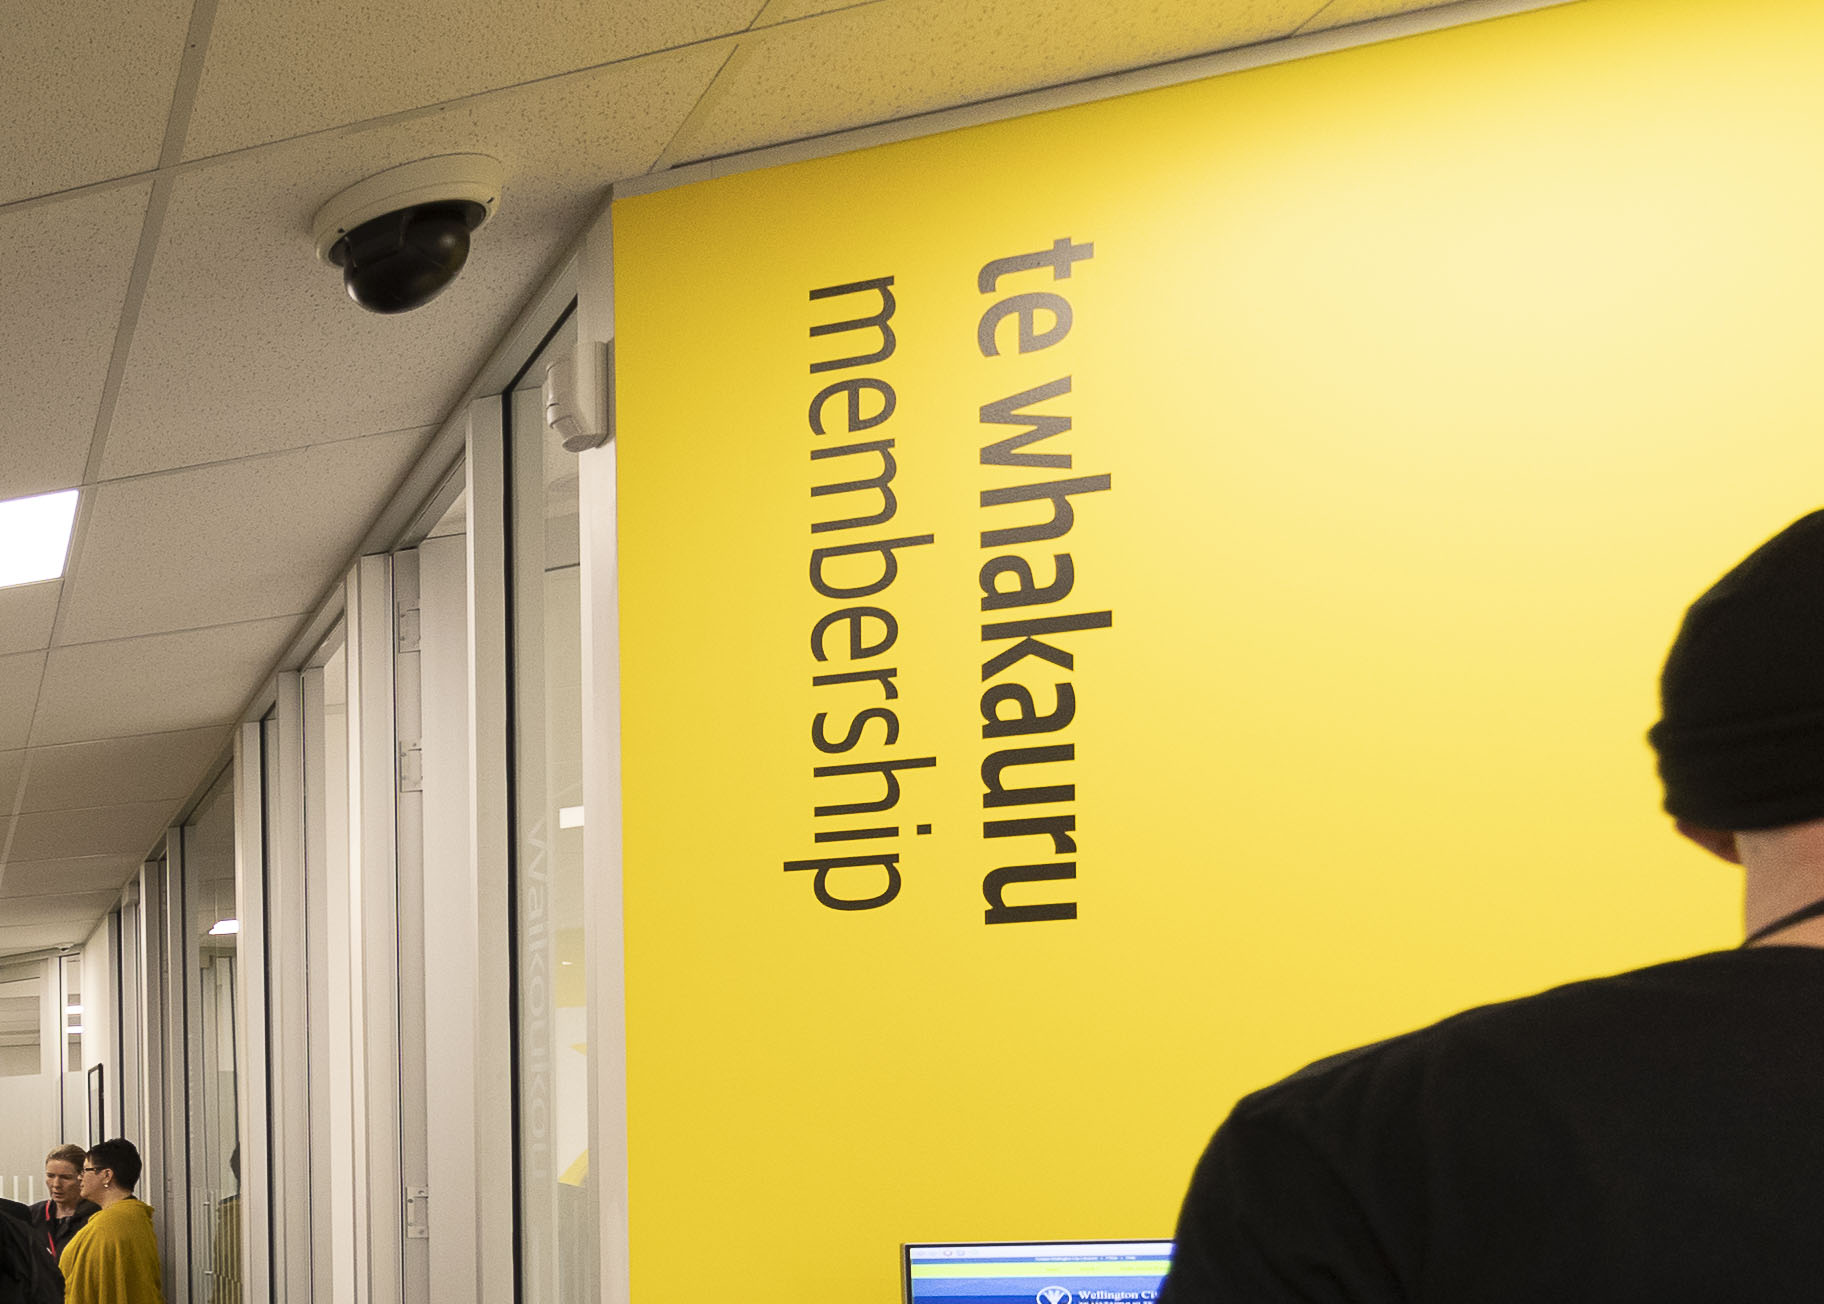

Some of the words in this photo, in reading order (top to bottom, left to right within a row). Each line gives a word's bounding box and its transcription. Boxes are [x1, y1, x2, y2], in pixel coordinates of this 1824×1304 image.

[977, 237, 1094, 358] te
[783, 275, 937, 911] membership
[979, 374, 1113, 925] whakauru
[1078, 1290, 1139, 1302] Wellington
